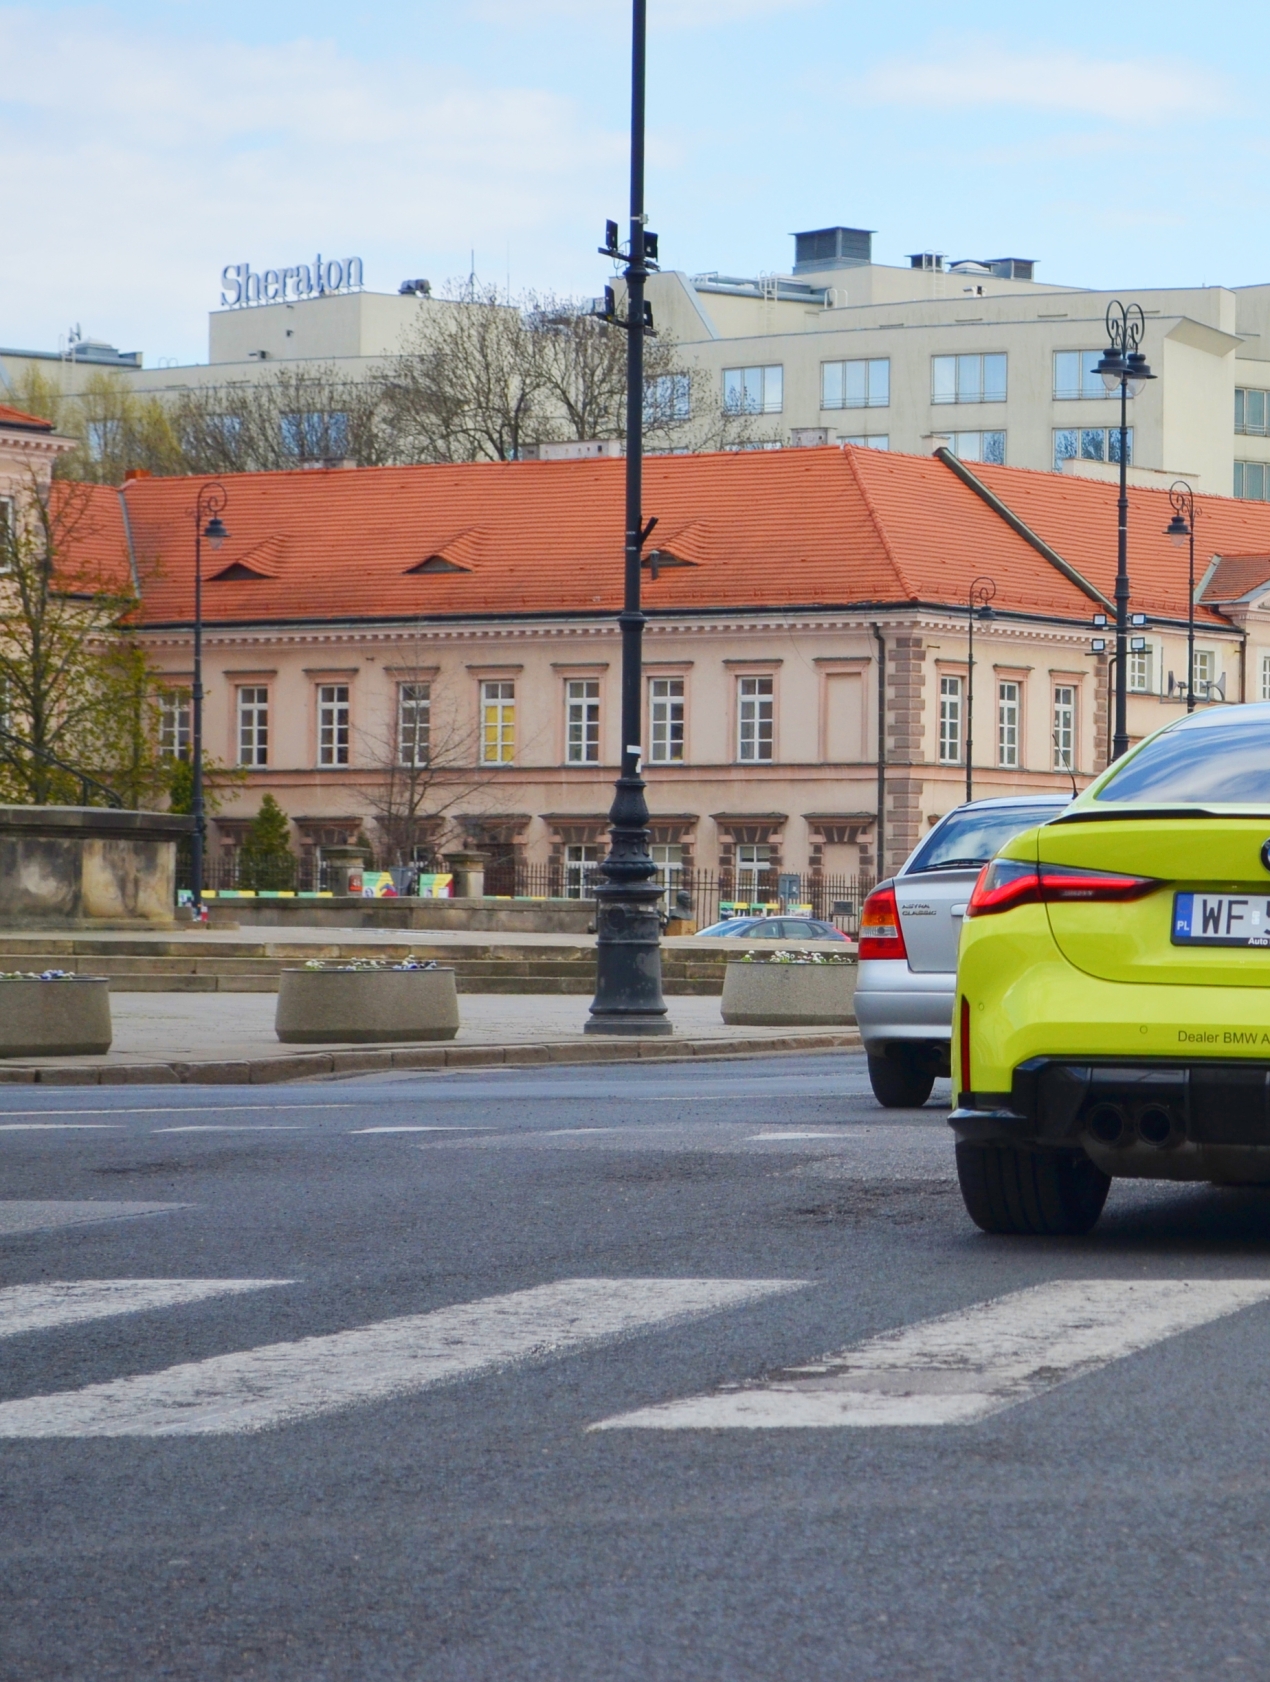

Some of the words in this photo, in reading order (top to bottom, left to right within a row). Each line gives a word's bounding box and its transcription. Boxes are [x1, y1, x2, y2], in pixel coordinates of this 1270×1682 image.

[221, 253, 364, 306] Sheraton
[1202, 899, 1249, 935] WF
[1177, 920, 1190, 931] PL
[1248, 938, 1268, 946] Auto
[1178, 1030, 1219, 1043] Dealer
[1223, 1032, 1258, 1044] BMW
